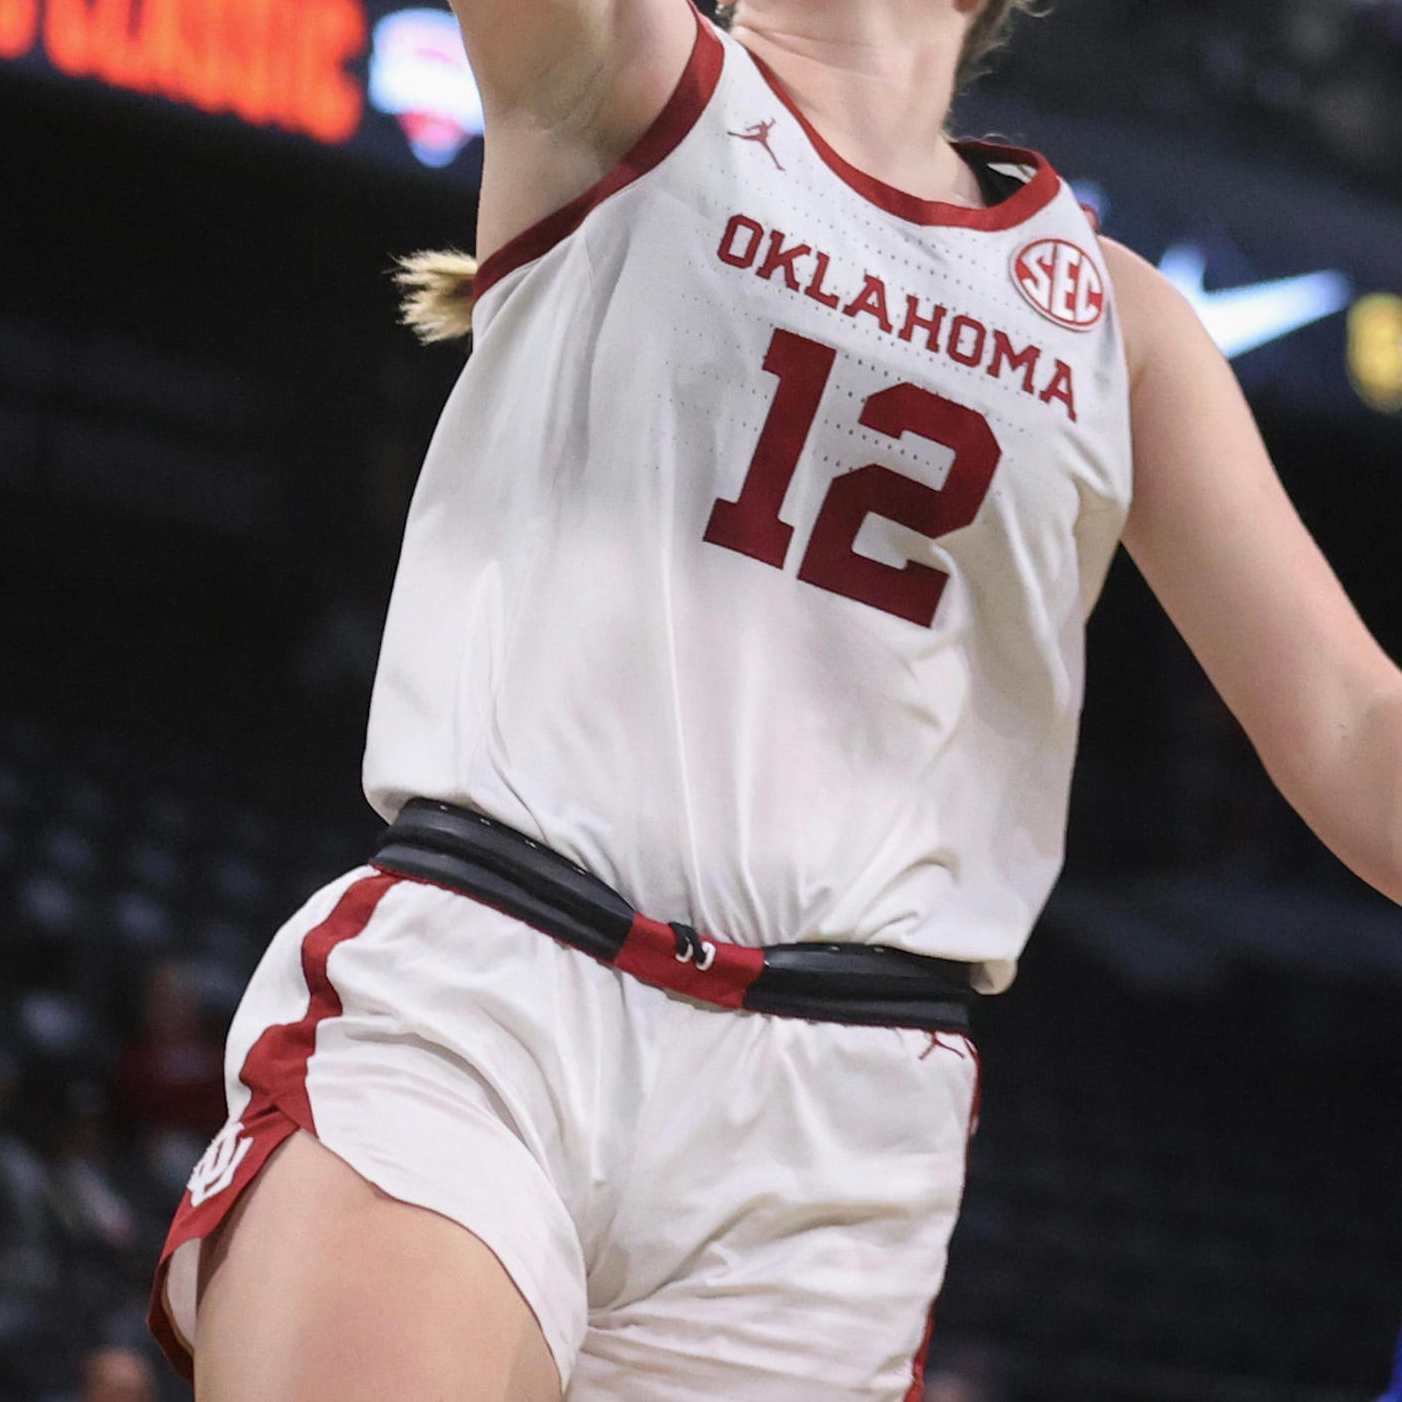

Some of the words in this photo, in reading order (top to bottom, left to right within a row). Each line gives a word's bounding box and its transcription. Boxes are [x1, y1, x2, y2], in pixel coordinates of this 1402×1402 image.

[717, 214, 1078, 423] OKLAHOMA
[1013, 243, 1104, 328] SEC
[702, 328, 1002, 630] 12
